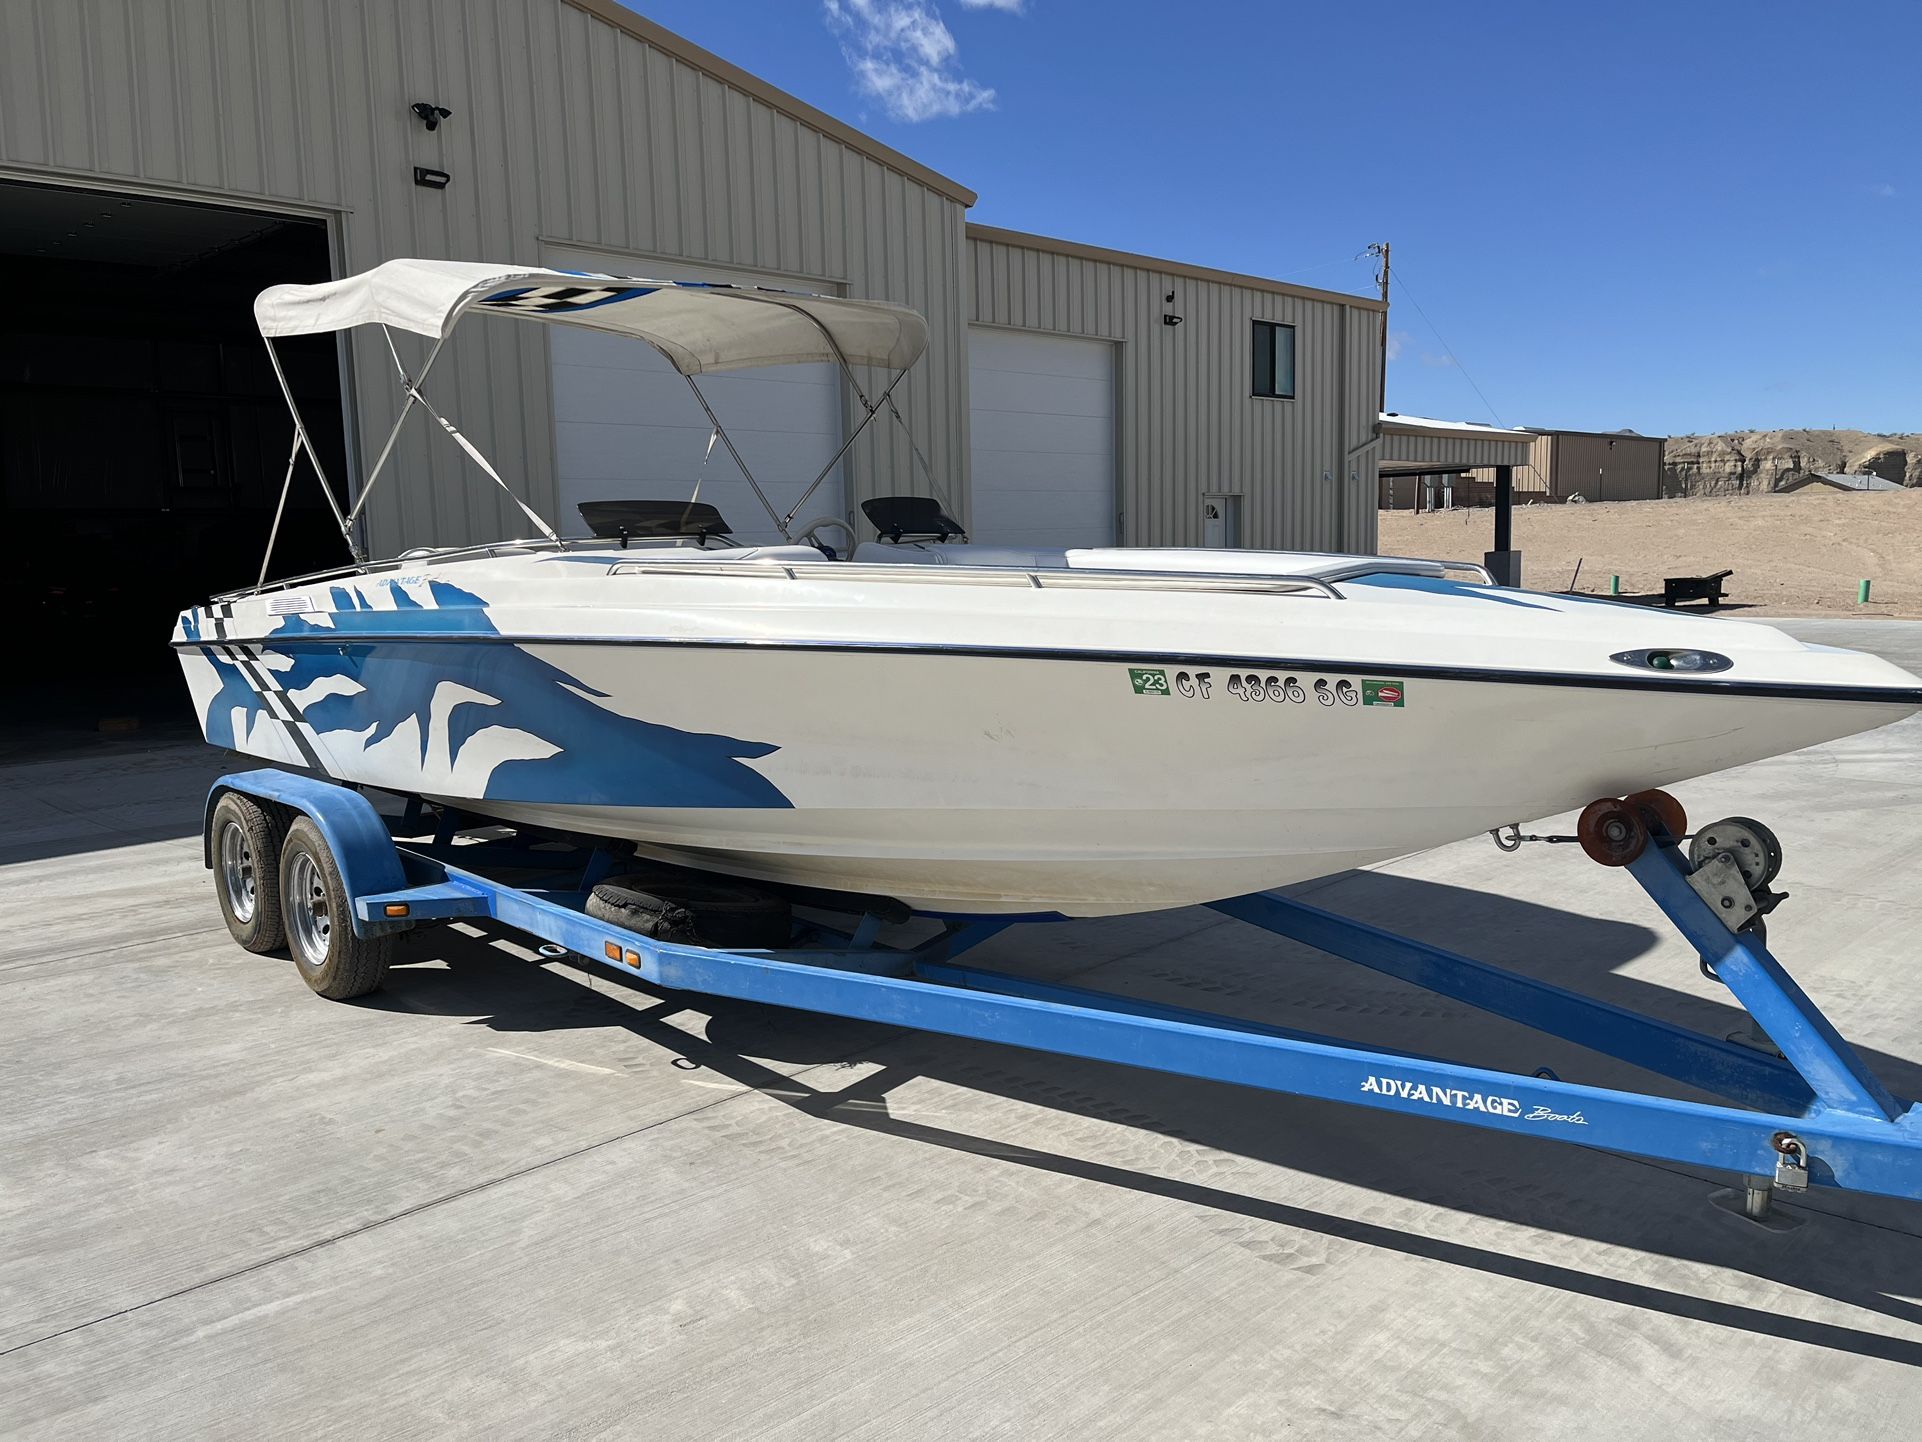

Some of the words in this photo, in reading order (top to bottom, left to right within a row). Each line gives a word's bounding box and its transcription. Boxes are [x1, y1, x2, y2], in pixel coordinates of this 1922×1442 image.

[1142, 674, 1167, 689] 23
[1175, 671, 1212, 700] CF
[1227, 673, 1306, 704] 4366
[1313, 678, 1359, 707] SG
[1360, 1075, 1522, 1118] ADVANTAGE
[1524, 1105, 1589, 1125] Boats
